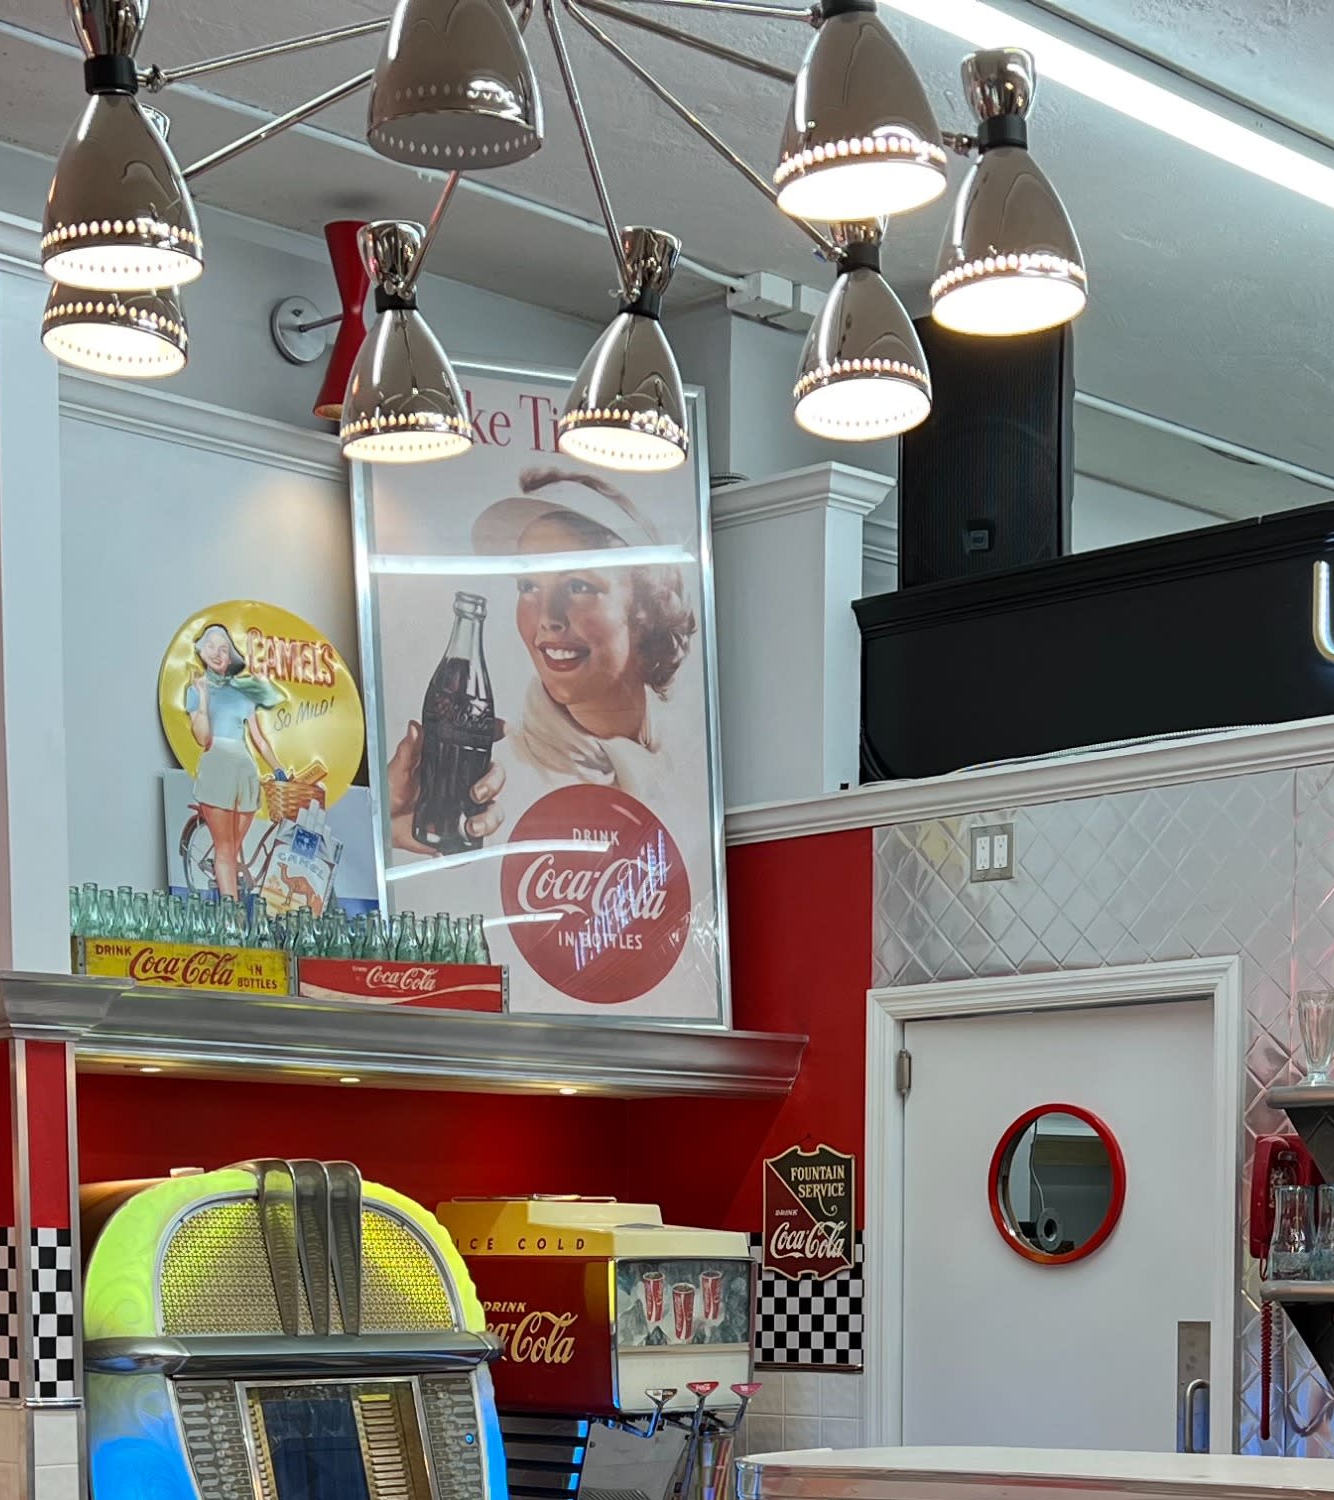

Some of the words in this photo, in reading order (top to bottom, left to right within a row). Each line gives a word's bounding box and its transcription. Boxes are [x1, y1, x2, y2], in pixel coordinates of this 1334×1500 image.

[247, 627, 336, 688] CAMELS
[573, 828, 620, 846] DRINK
[518, 853, 672, 920] Coca-Cola
[558, 931, 575, 947] IN
[95, 944, 132, 956] DRINK
[129, 947, 238, 986] Coca-Cola
[237, 977, 277, 989] BOTTLES
[367, 965, 439, 990] Coca-Cola
[790, 1165, 845, 1181] FOUNTAIN
[798, 1183, 845, 1202] SERVICE
[775, 1208, 798, 1216] DRINK
[517, 1238, 585, 1250] COLD
[770, 1221, 848, 1259] Coca-Cola
[483, 1301, 527, 1313] DRINK
